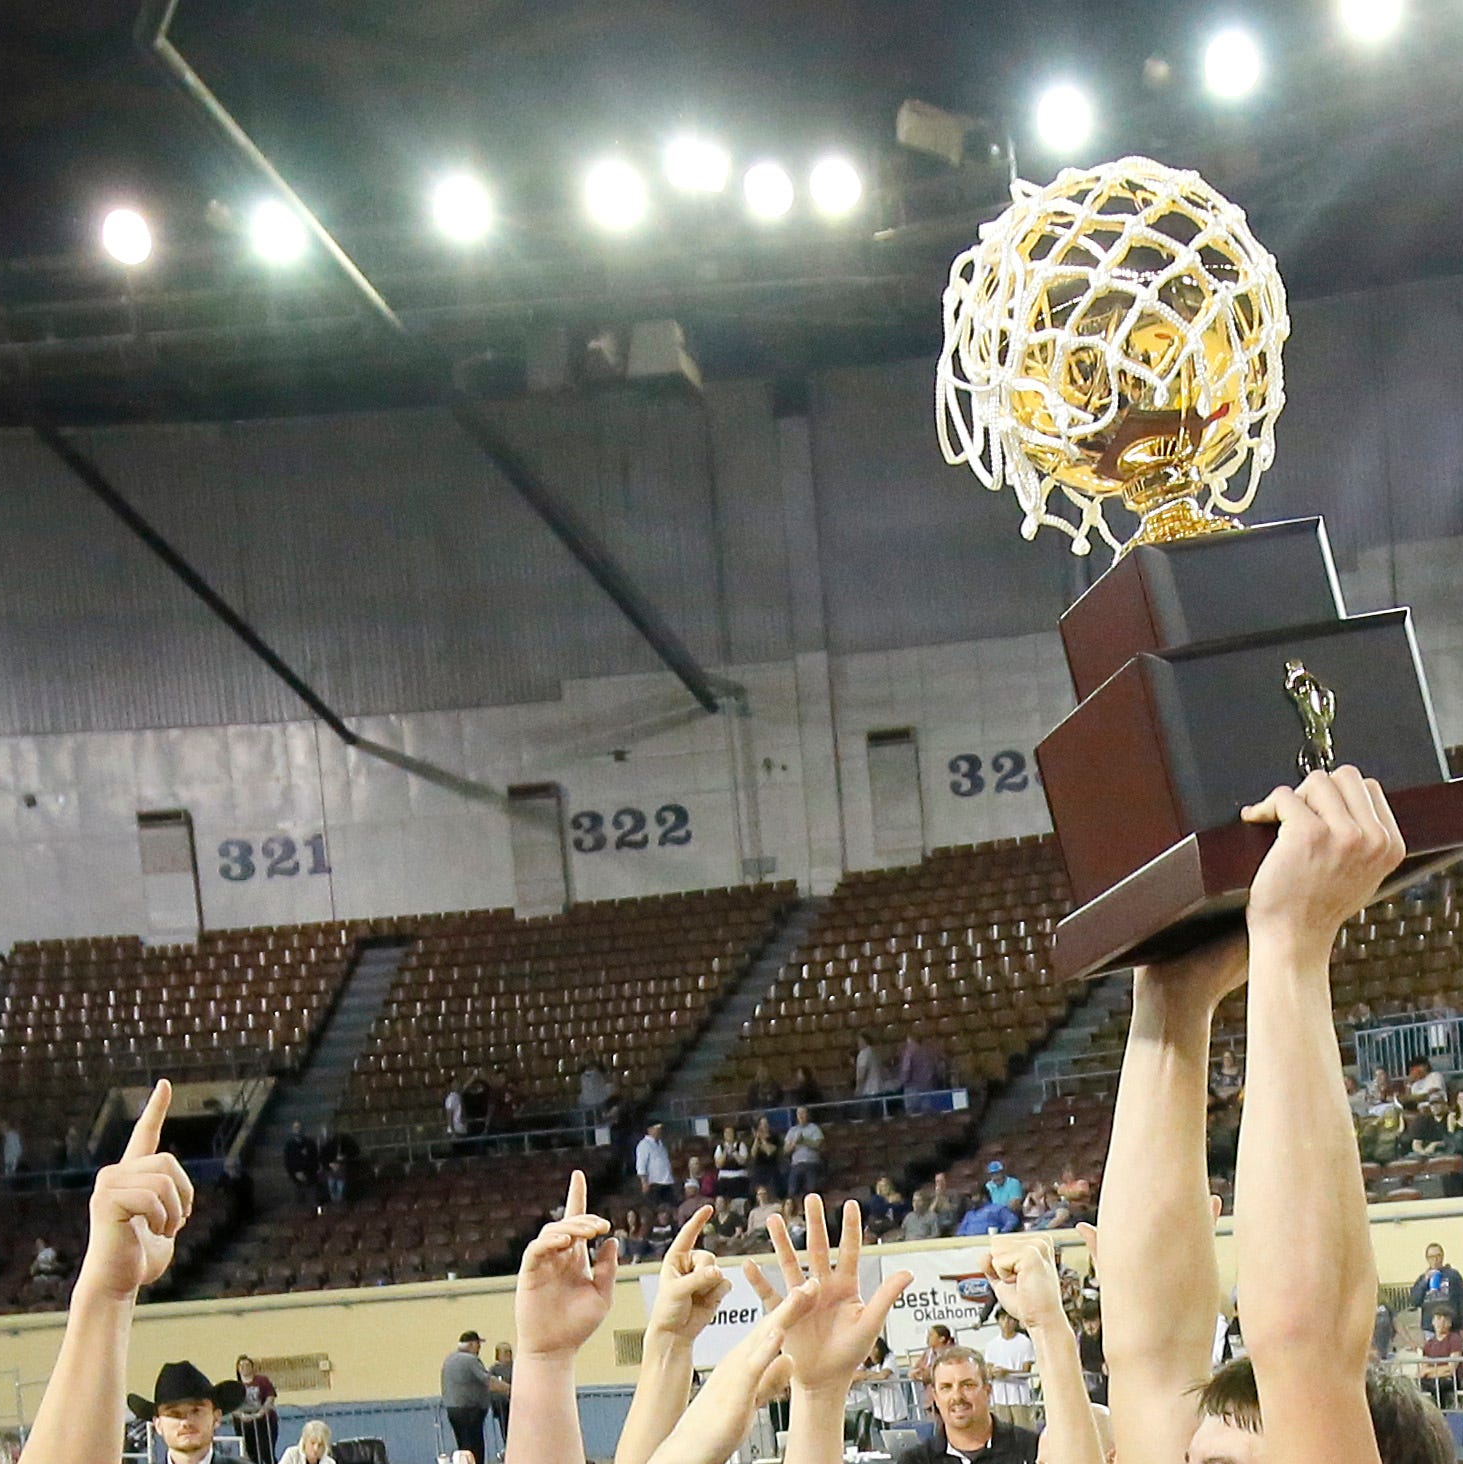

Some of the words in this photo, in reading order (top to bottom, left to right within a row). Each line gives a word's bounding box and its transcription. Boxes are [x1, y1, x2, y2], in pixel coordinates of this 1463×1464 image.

[948, 750, 1043, 797] 32
[571, 803, 693, 853] 322
[218, 833, 332, 882] 321
[943, 1291, 957, 1305] in
